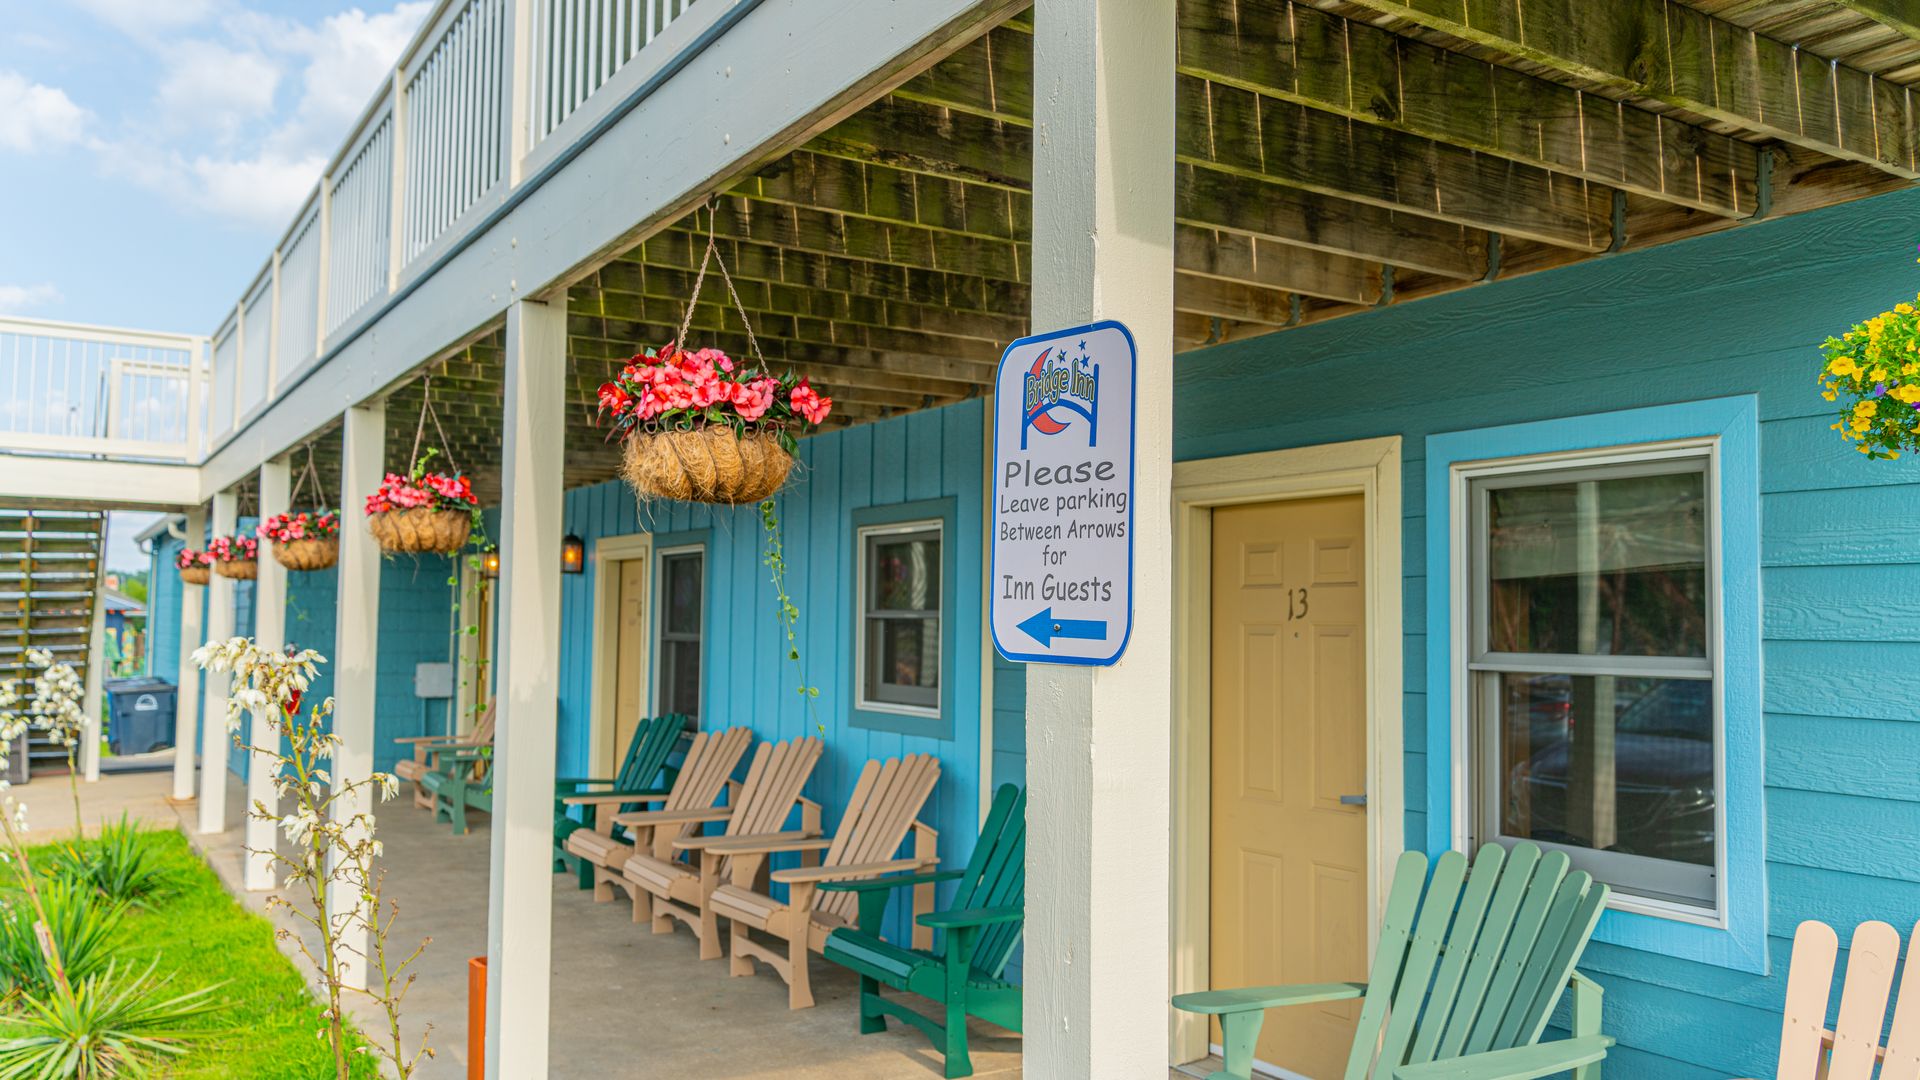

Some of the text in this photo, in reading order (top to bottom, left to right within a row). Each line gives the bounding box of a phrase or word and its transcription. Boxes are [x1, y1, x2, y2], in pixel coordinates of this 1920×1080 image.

[1026, 358, 1096, 411] Bridge Inn
[1005, 460, 1116, 488] Please
[1000, 487, 1127, 517] Leave parking
[1000, 520, 1126, 541] Between Arrows
[1042, 545, 1067, 566] for
[1003, 574, 1112, 602] Inn Guests
[1287, 588, 1309, 621] 13
